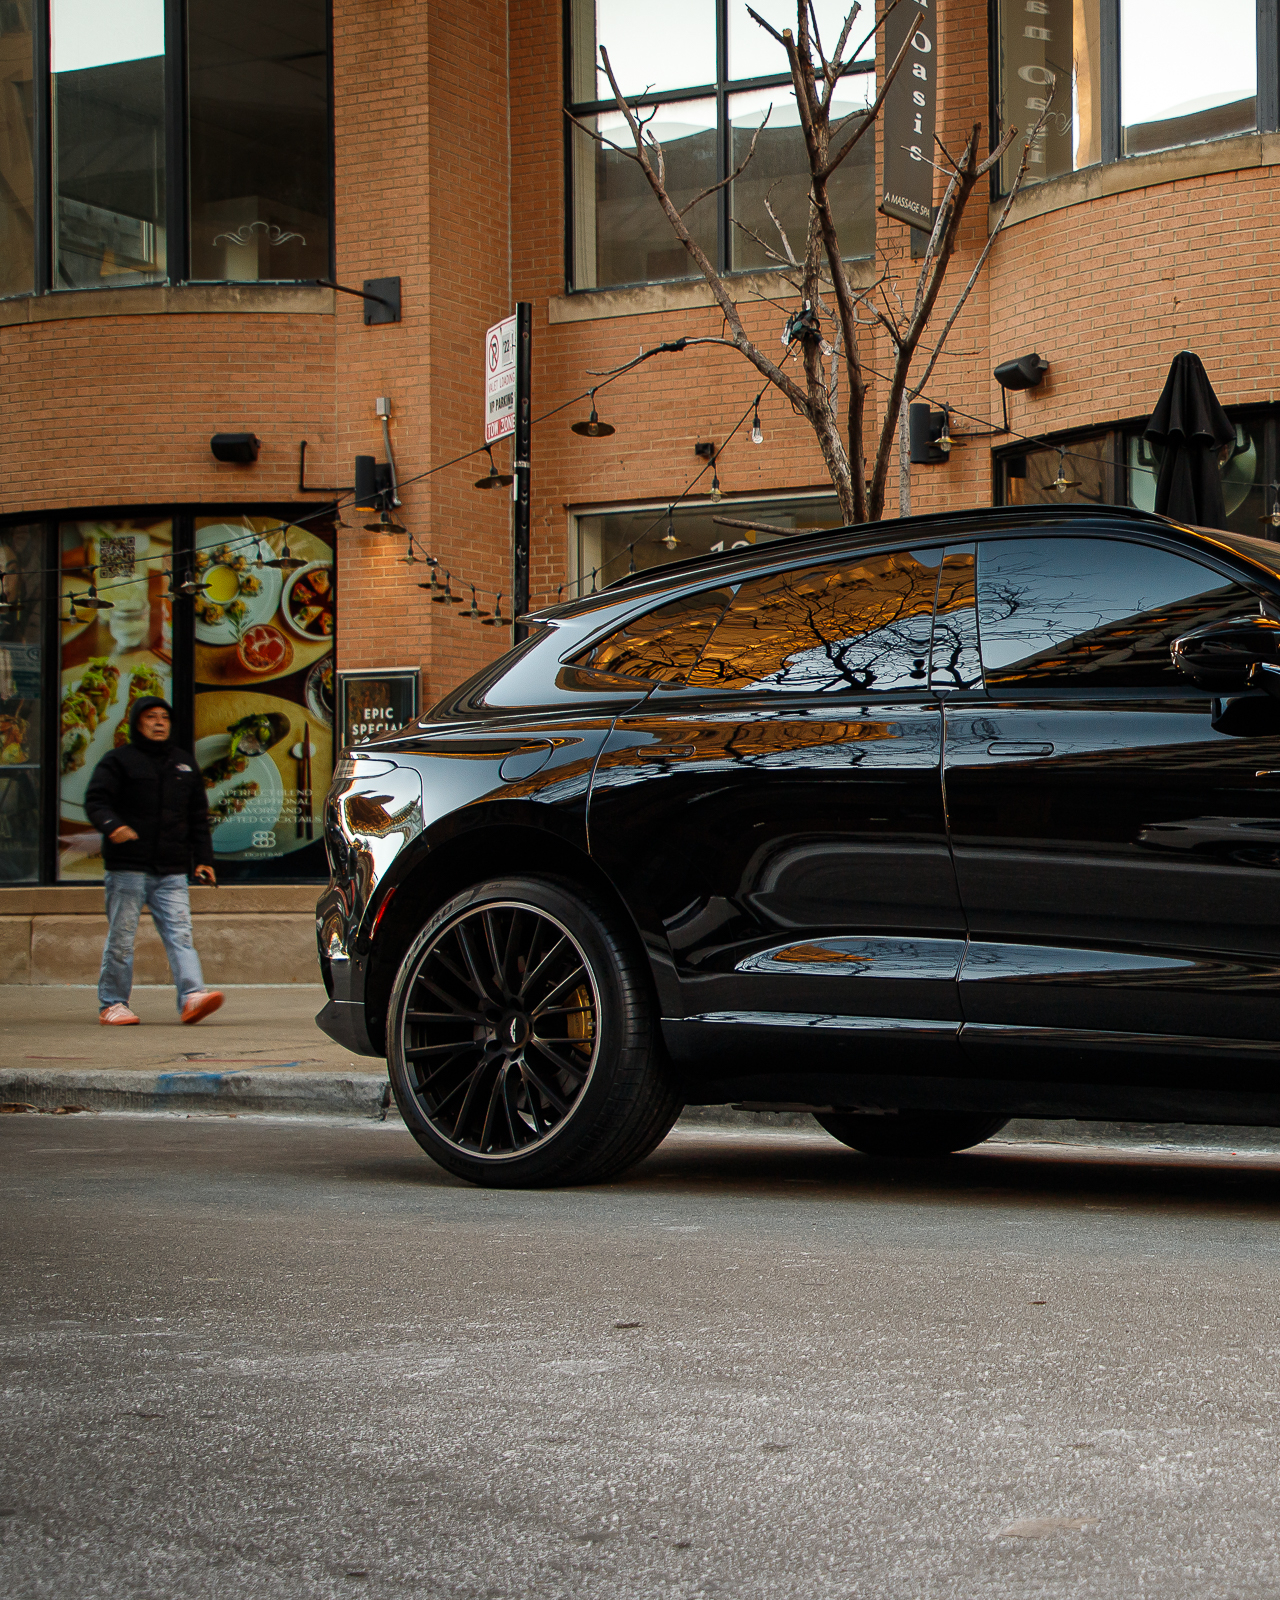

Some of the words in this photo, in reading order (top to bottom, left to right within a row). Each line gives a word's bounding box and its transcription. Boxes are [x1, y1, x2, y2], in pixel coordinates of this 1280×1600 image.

[884, 191, 890, 202] A
[891, 194, 920, 213] MASSAGE
[920, 204, 930, 218] SPA
[495, 391, 514, 411] PARKING
[488, 420, 499, 437] TOW
[500, 413, 516, 433] ZONE
[363, 706, 394, 720] EPIC
[259, 815, 323, 823] COCKTAILS
